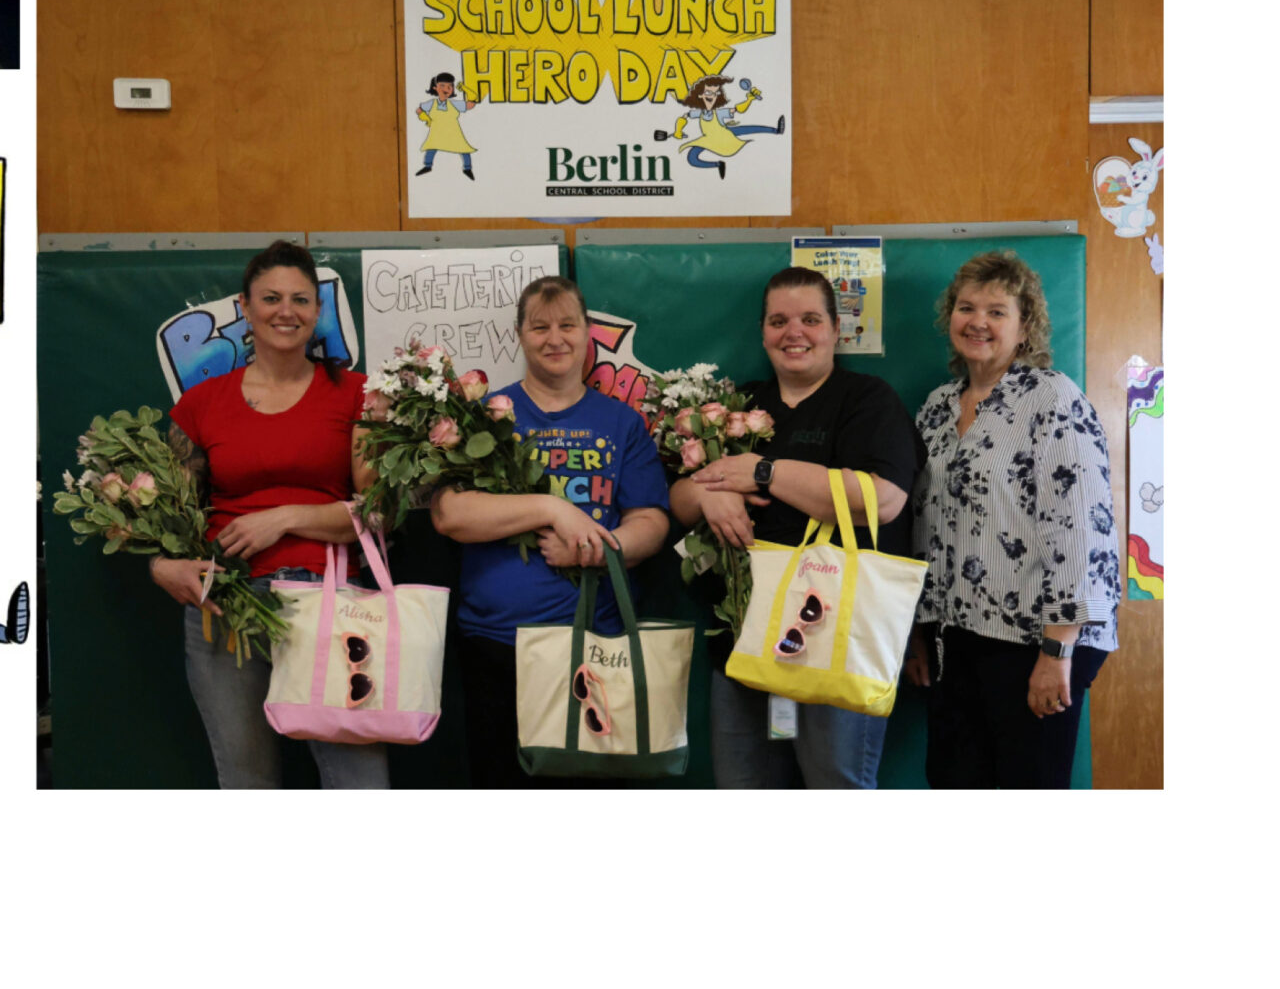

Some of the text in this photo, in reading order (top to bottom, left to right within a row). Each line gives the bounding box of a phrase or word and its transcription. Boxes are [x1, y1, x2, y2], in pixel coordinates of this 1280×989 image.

[461, 48, 737, 104] HERO DAY
[546, 144, 673, 182] Berlin
[548, 187, 672, 196] CENTRAL SCHOOL DISTRICT
[546, 438, 565, 447] with
[570, 429, 590, 438] UP!
[529, 448, 603, 471] UPER
[549, 474, 613, 506] NCH
[338, 604, 384, 623] Alisha
[589, 644, 629, 668] Beth
